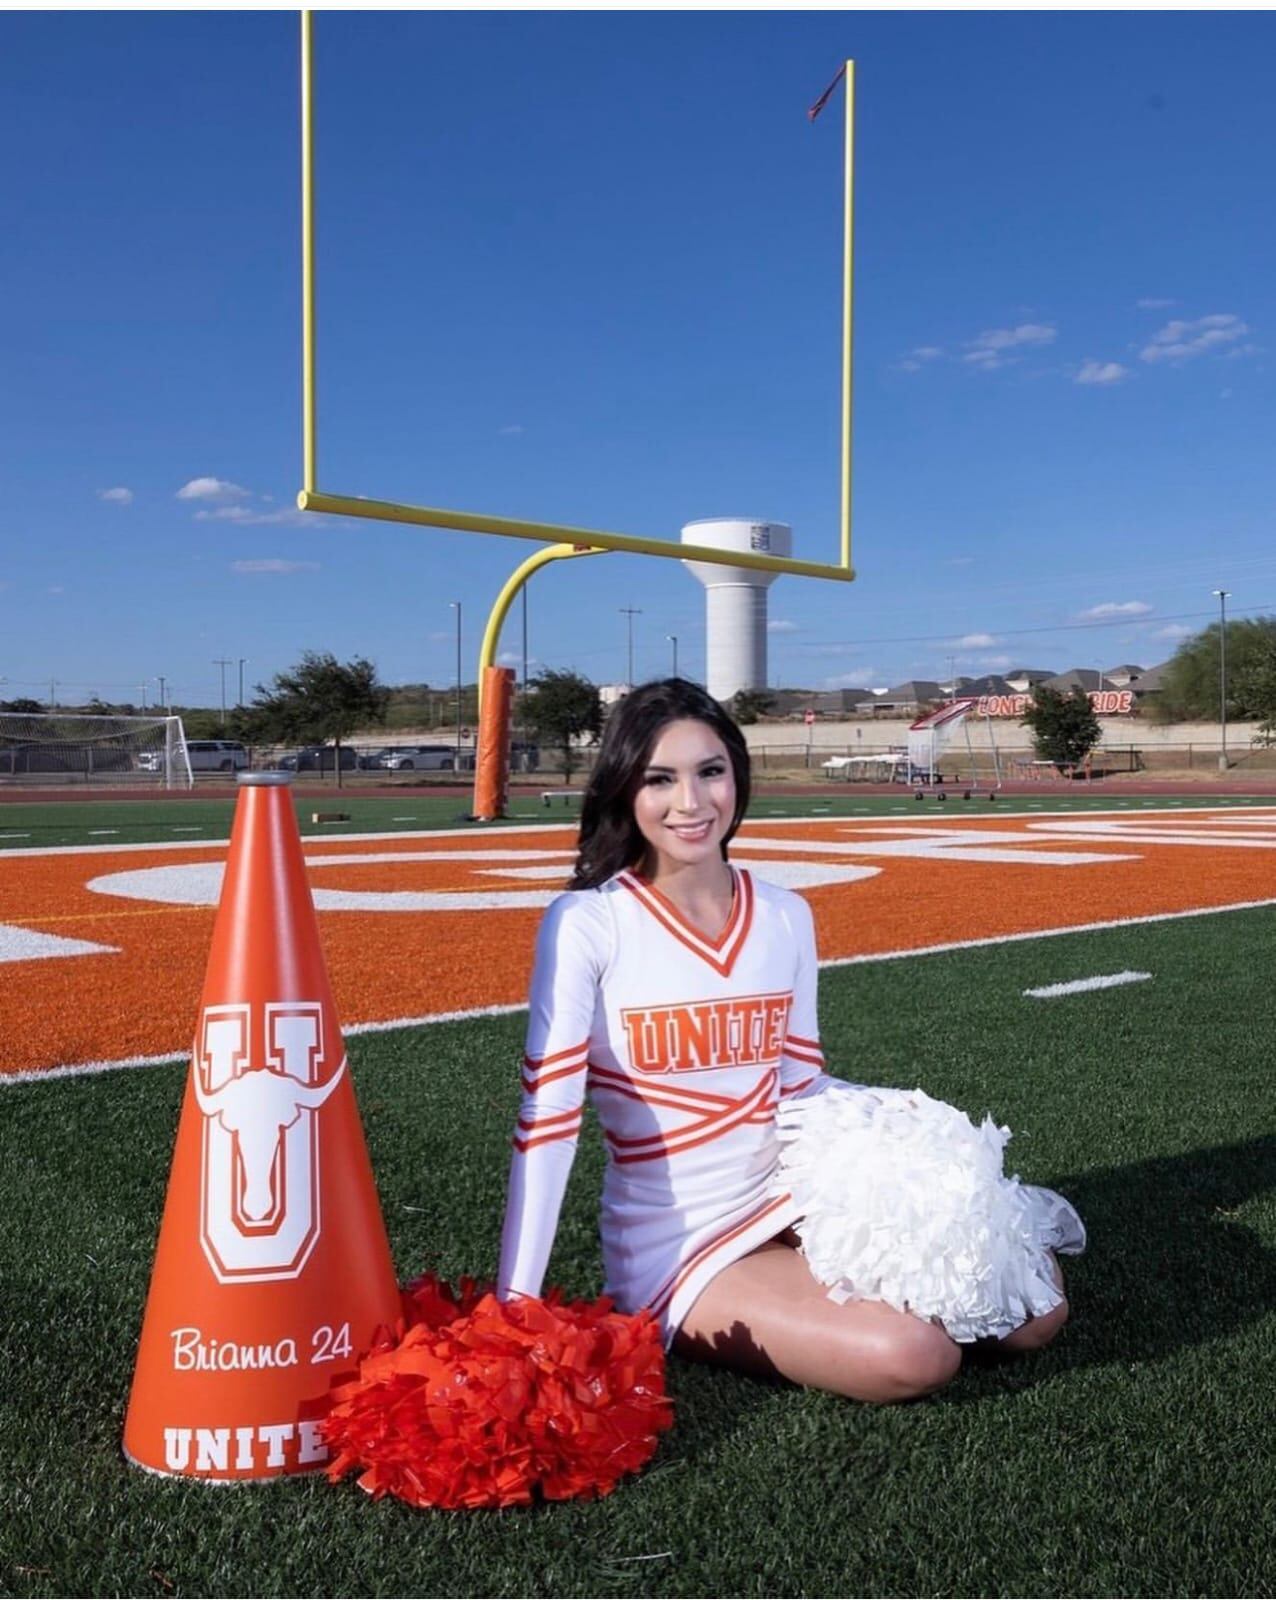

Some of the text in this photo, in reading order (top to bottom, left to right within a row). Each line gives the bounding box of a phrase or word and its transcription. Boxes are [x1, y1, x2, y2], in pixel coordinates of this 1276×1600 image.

[978, 690, 1132, 717] LONG RIDE
[620, 990, 793, 1075] UNITE
[170, 1322, 352, 1371] Brianna 24
[164, 1420, 328, 1471] UNITE
